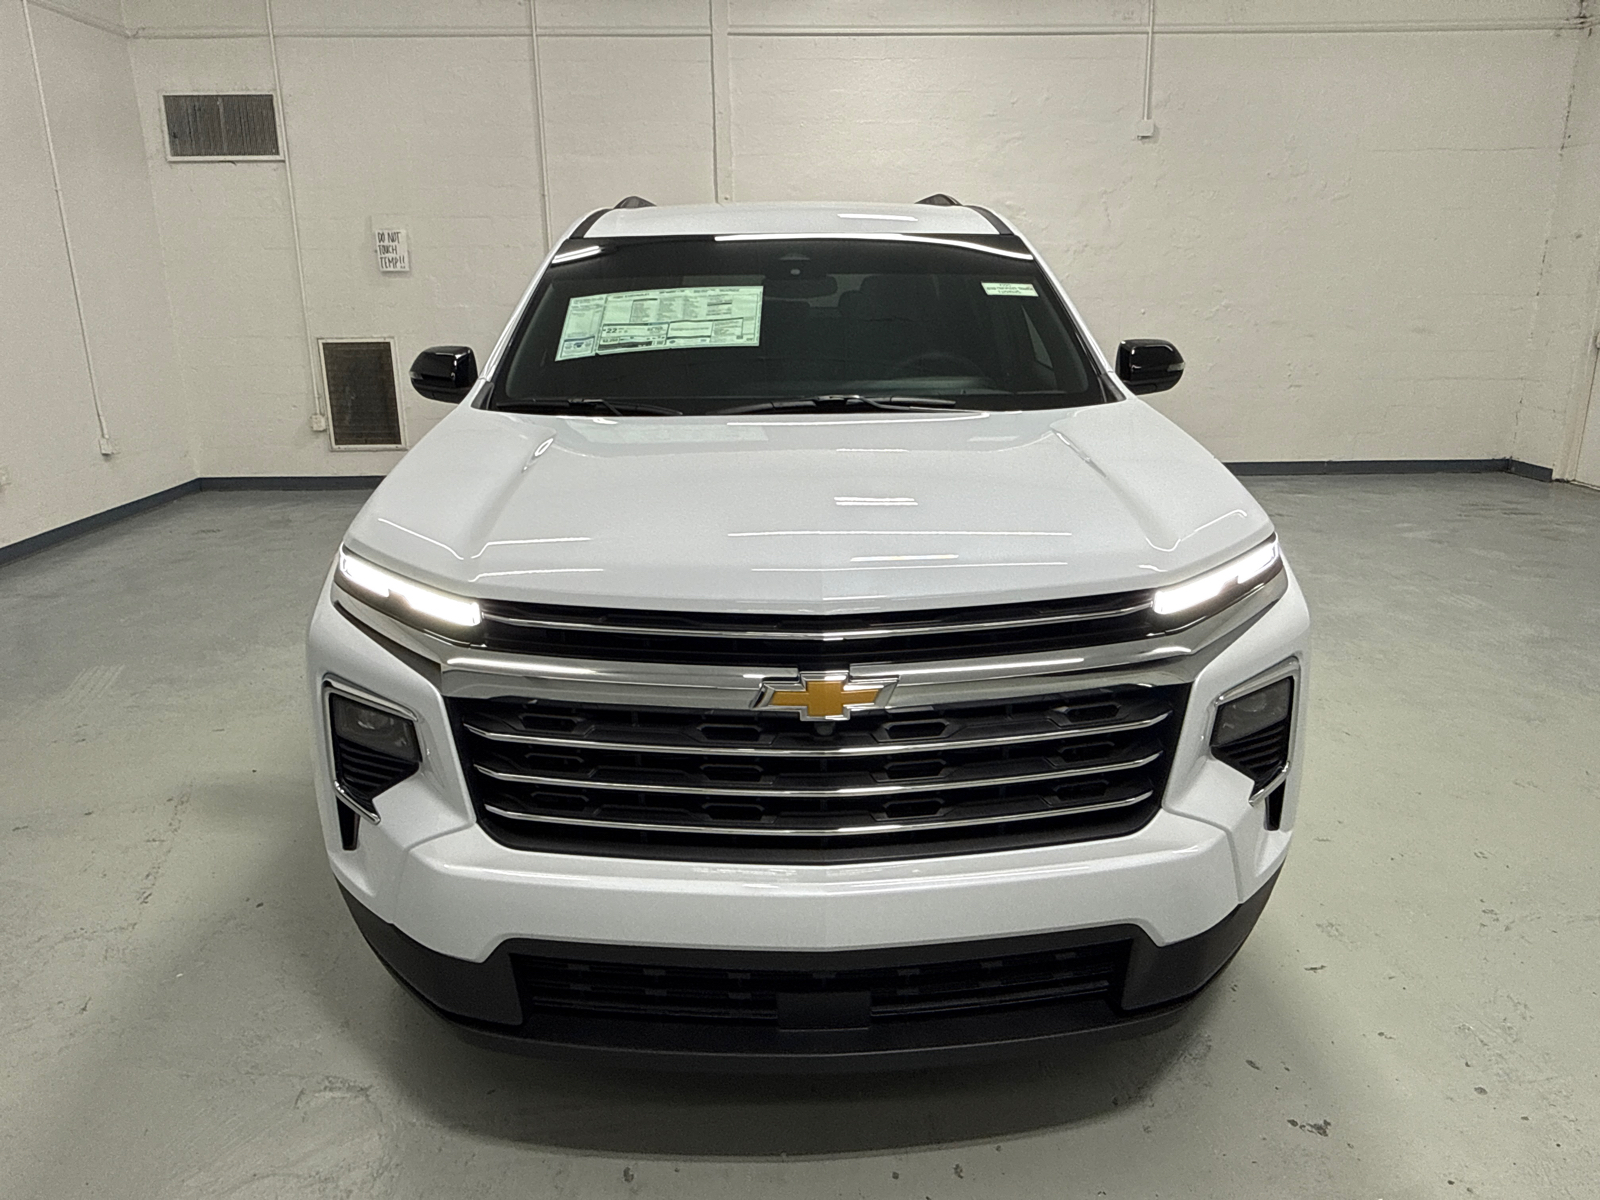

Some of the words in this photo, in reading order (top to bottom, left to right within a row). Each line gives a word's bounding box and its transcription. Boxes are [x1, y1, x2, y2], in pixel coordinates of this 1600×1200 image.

[378, 232, 385, 243] DO
[387, 232, 401, 244] NOT
[378, 245, 398, 255] TOUCH
[380, 255, 405, 269] TEMP!!
